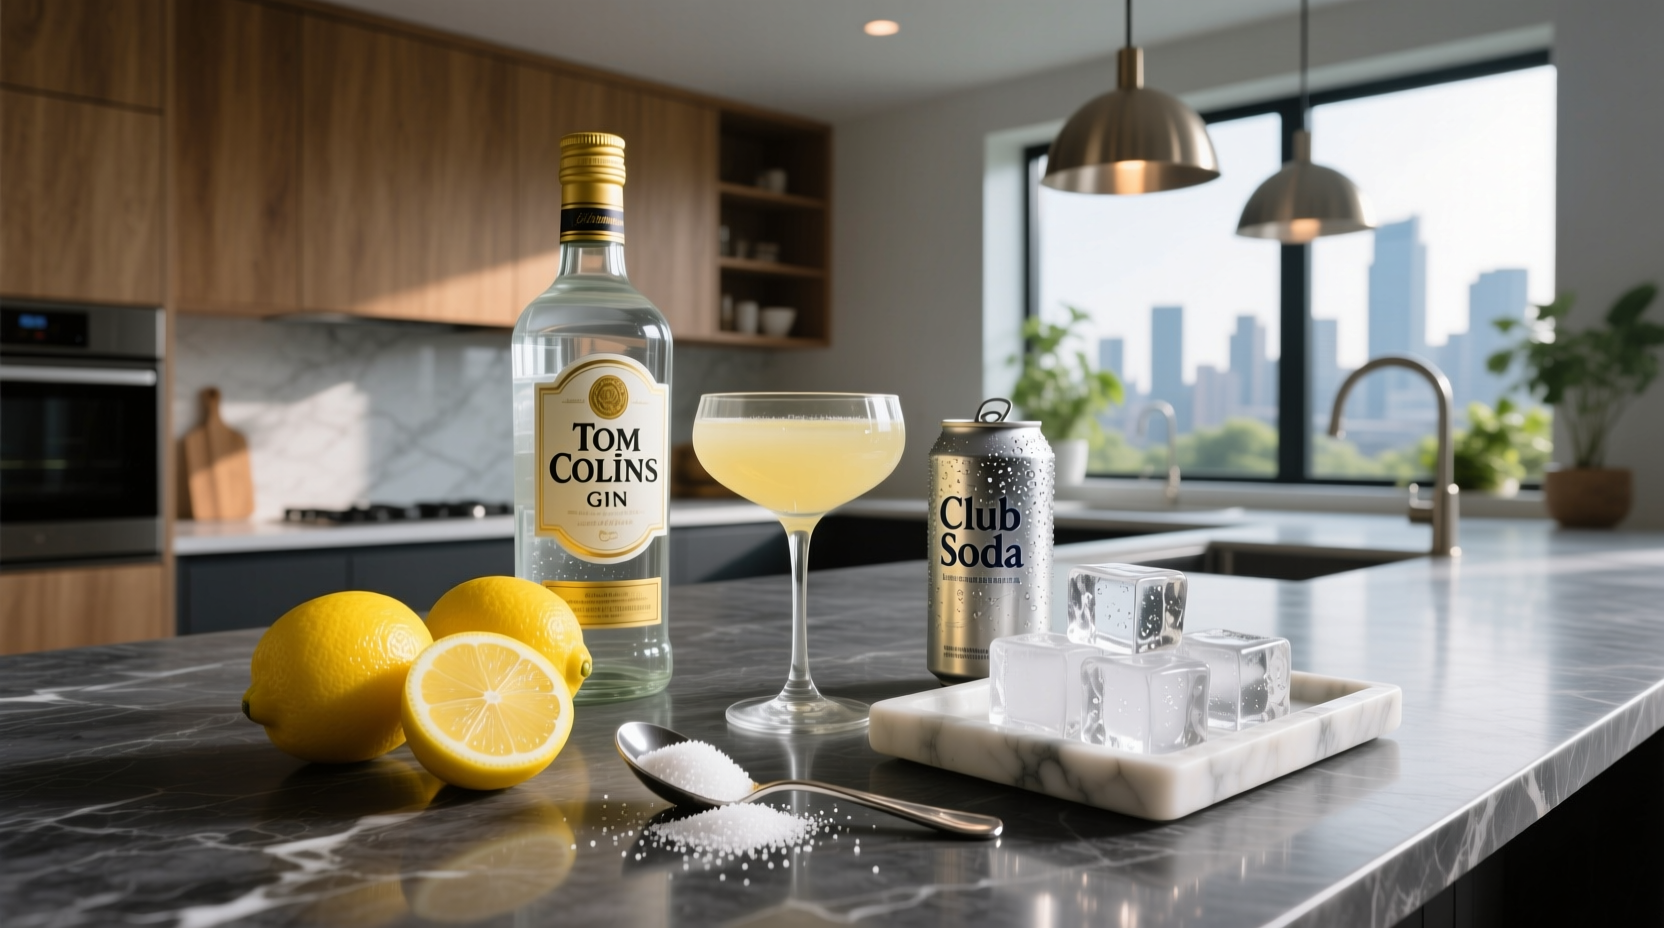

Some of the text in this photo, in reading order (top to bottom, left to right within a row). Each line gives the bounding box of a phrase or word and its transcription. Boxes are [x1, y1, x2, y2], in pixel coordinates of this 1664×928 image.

[572, 422, 641, 452] TOM
[586, 491, 627, 508] GIN
[940, 495, 1021, 531] Club
[940, 532, 1024, 568] Soda
